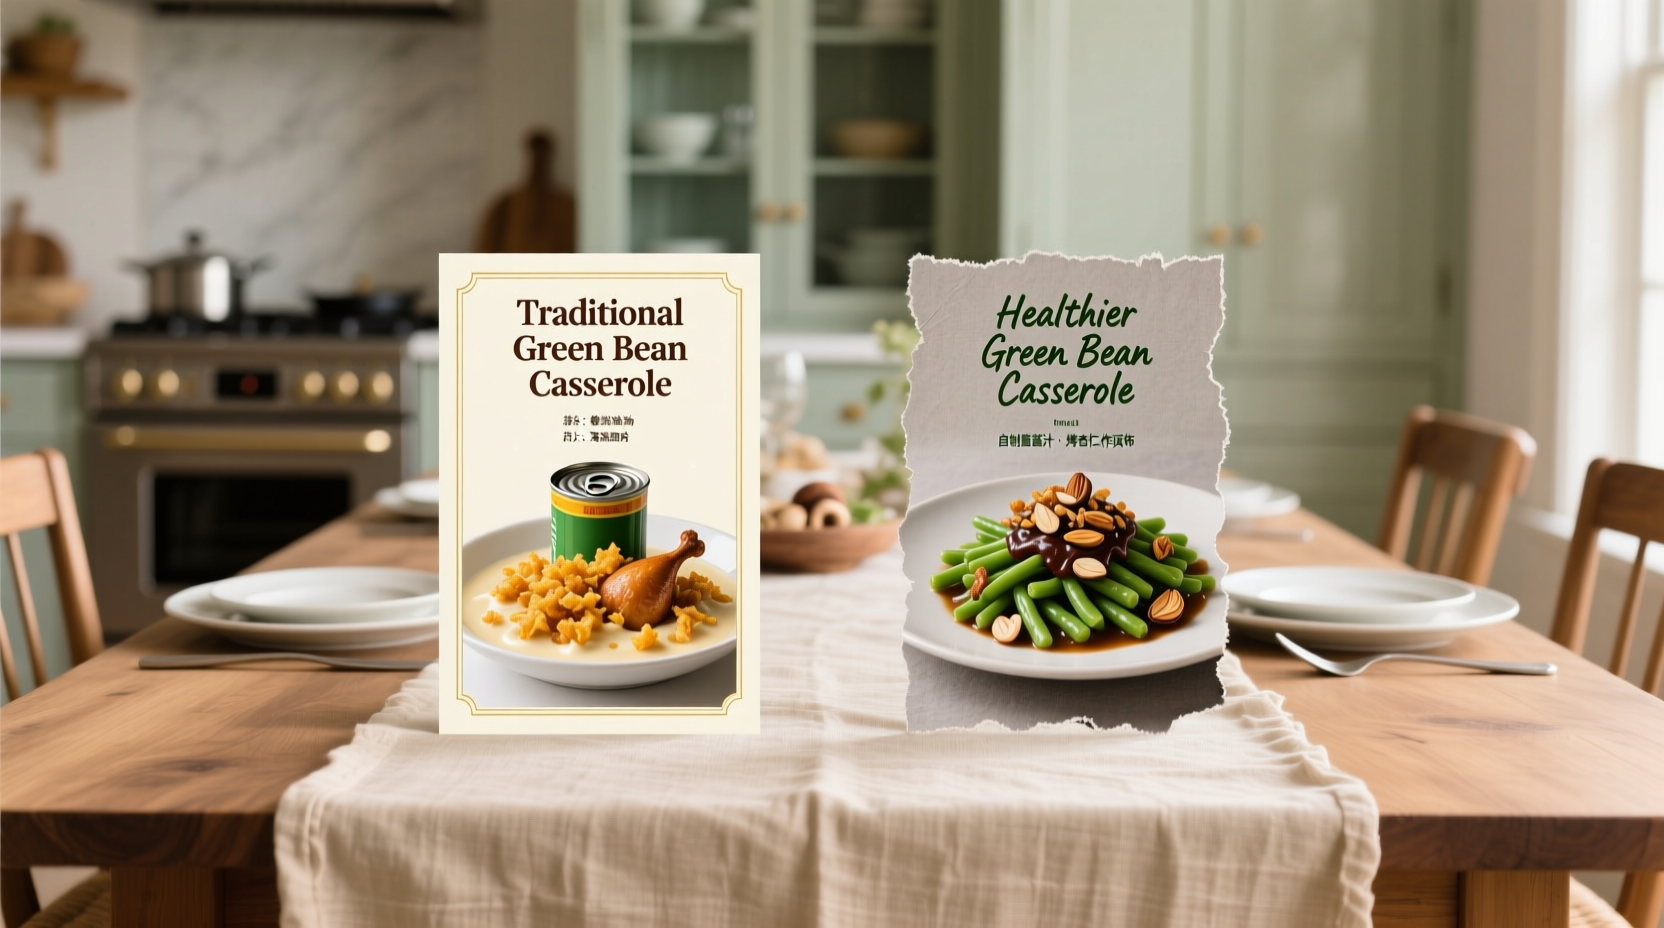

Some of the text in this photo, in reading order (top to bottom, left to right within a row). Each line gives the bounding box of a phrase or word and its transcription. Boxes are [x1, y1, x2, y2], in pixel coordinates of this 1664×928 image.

[517, 298, 683, 326] Traditional
[997, 293, 1137, 329] Healthier
[513, 335, 688, 361] Green Bean
[982, 333, 1153, 372] Green Bean
[529, 369, 672, 397] Casserole
[998, 370, 1135, 406] Casserole
